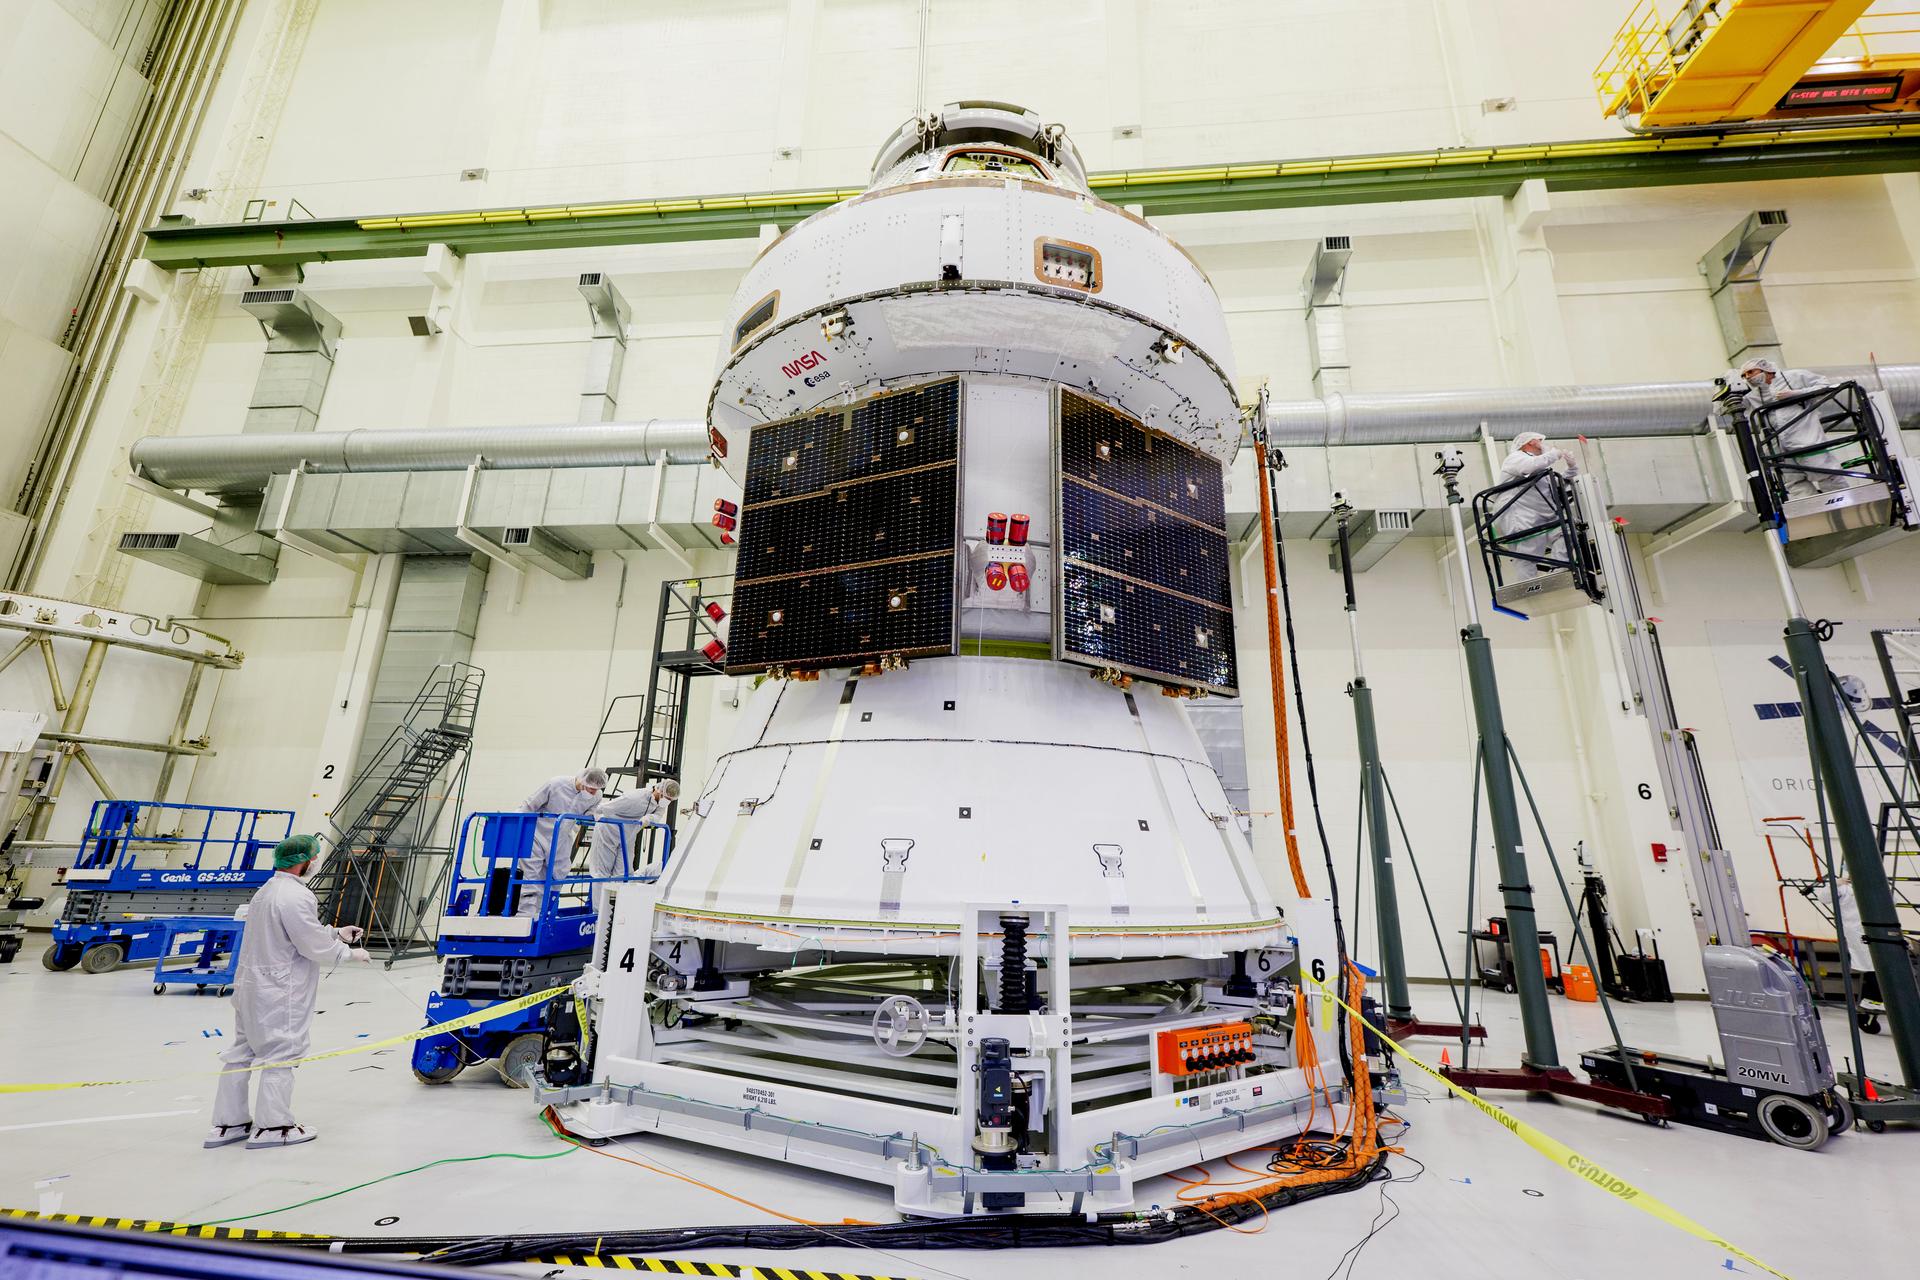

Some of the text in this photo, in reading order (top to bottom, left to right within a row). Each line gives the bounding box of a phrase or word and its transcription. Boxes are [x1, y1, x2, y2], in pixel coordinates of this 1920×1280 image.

[781, 350, 828, 379] NASA
[322, 764, 335, 779] 2
[1637, 783, 1652, 800] 6
[1771, 778, 1817, 791] ORIO
[160, 872, 192, 882] Genie
[197, 872, 246, 882] GS-2632
[579, 920, 596, 937] Gen
[619, 947, 635, 973] 4
[669, 940, 682, 964] 4
[1258, 950, 1271, 972] 6
[1311, 958, 1326, 983] 6
[1738, 1066, 1790, 1085] 20MVL
